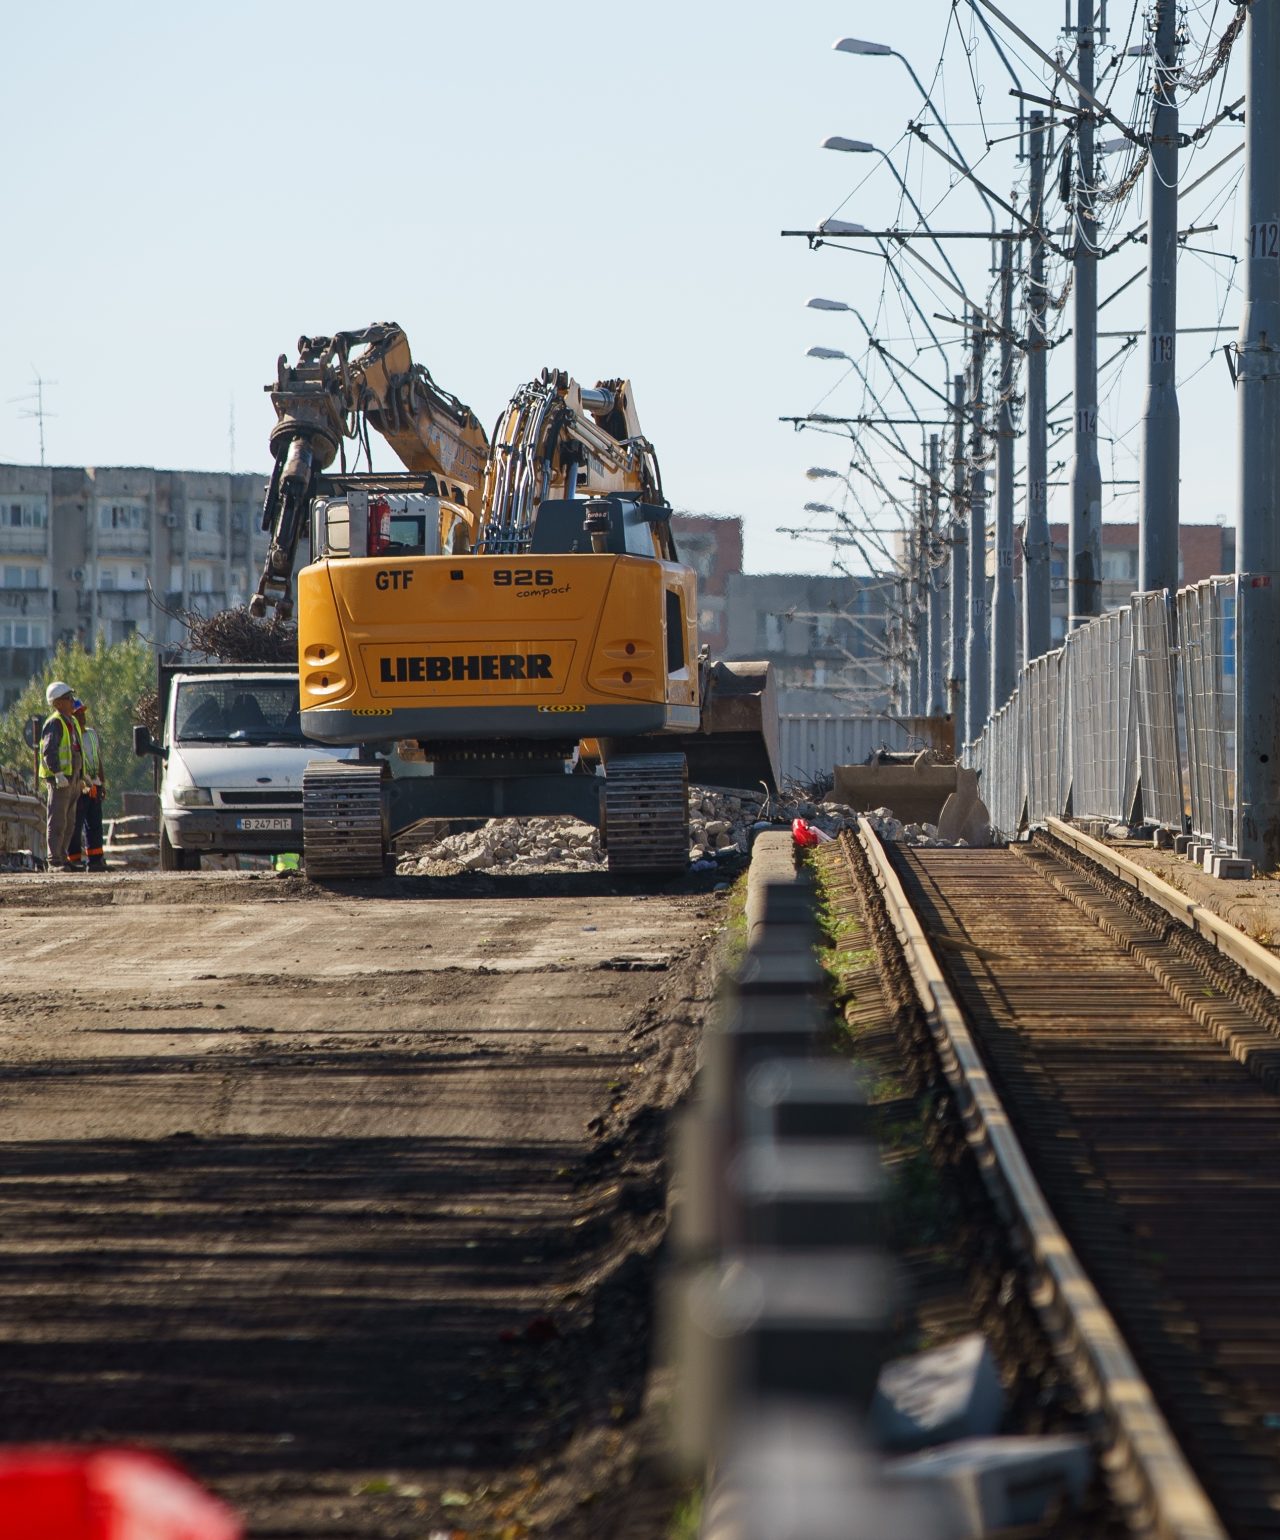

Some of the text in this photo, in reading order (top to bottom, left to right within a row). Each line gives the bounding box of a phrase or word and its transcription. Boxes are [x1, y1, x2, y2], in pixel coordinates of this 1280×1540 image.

[1250, 223, 1279, 258] 112
[1152, 335, 1173, 361] 113
[1077, 410, 1096, 432] 114
[375, 570, 414, 591] GTF
[493, 570, 554, 586] 926
[516, 583, 572, 598] compact
[380, 654, 553, 683] LIEBHERR
[244, 820, 251, 829] B
[254, 820, 270, 829] 247
